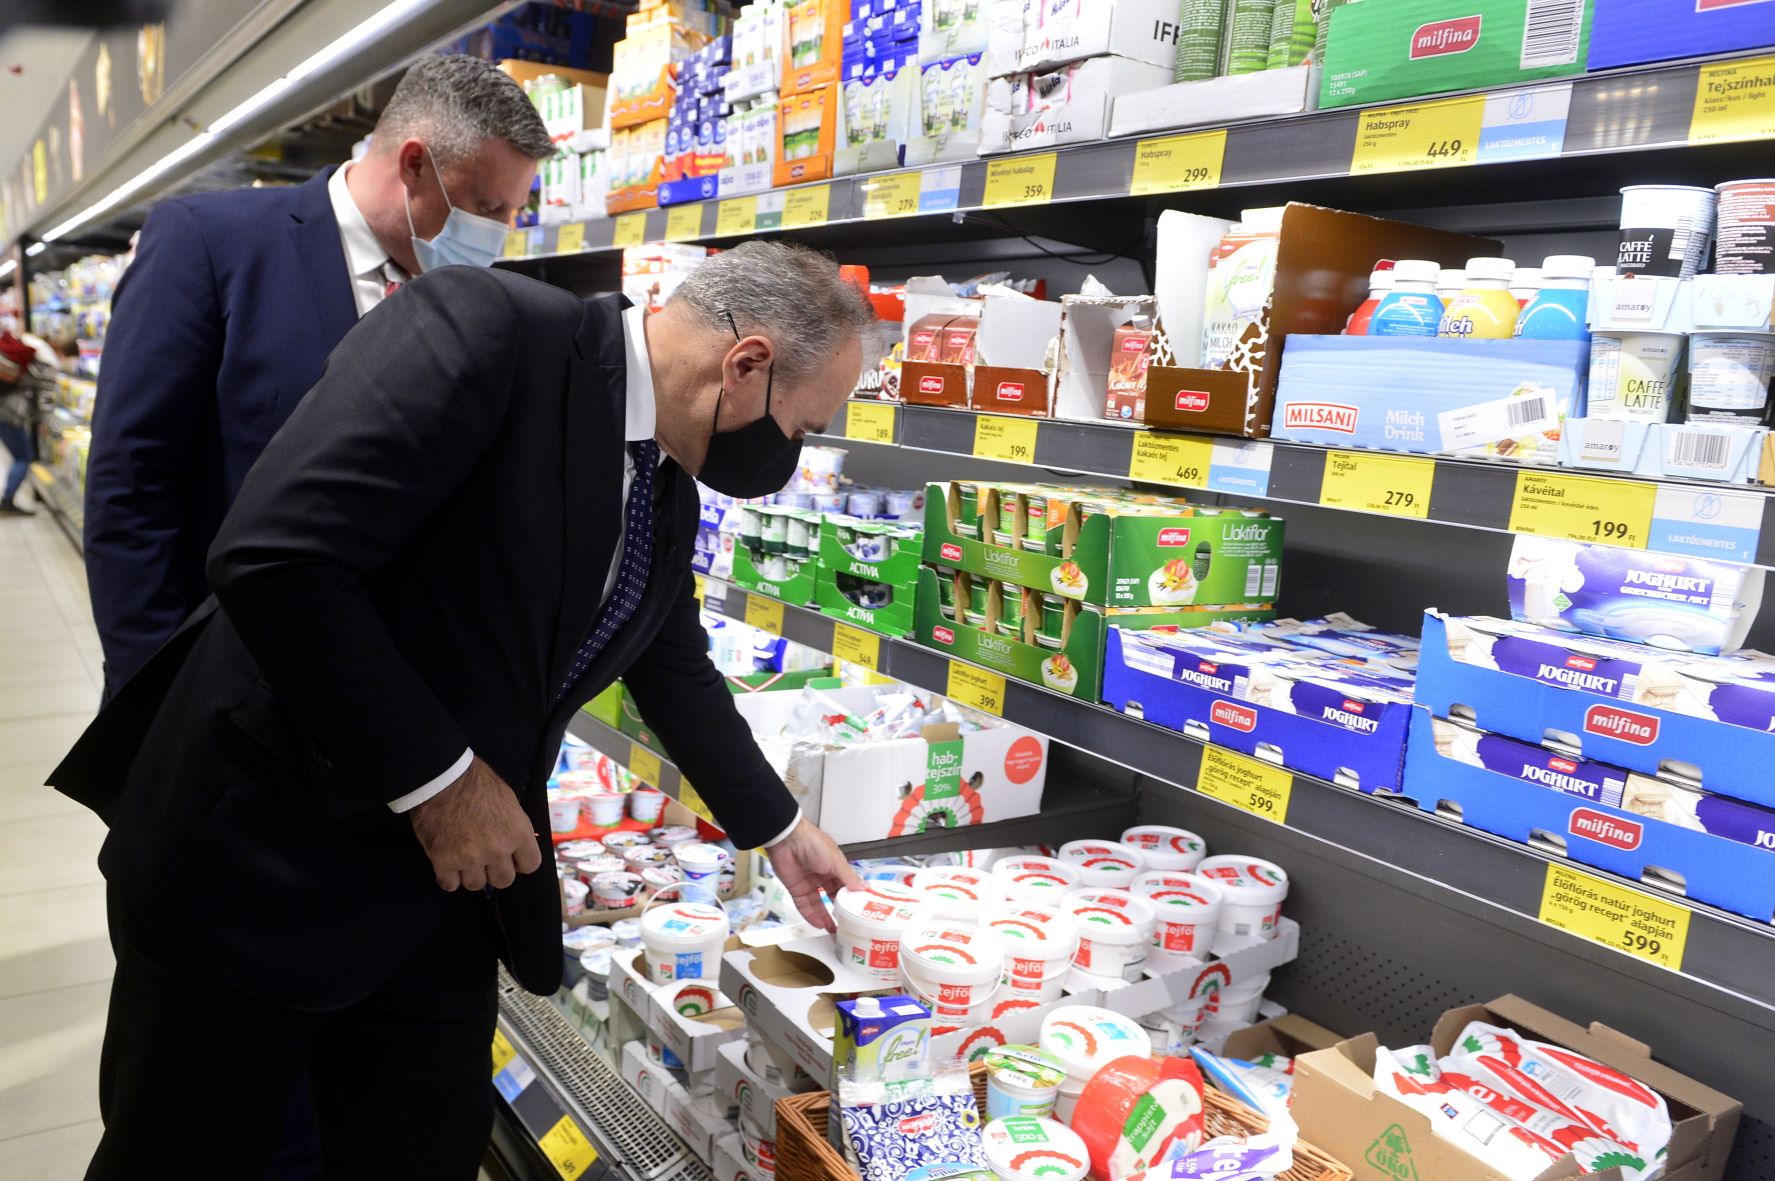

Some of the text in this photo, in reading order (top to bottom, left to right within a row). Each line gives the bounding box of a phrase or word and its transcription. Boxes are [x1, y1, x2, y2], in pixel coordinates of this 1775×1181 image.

[1051, 36, 1080, 50] ITALIA
[1416, 27, 1473, 49] milfina
[1046, 121, 1072, 135] ITLIA
[1366, 119, 1411, 131] Habspray
[1140, 150, 1172, 159] Habspray
[1427, 139, 1462, 158] 449
[1183, 167, 1208, 182] 299
[1023, 184, 1042, 198] 359
[899, 200, 913, 211] 279
[1618, 252, 1651, 263] LATTE
[1211, 322, 1238, 335] KAKAO
[1440, 315, 1474, 334] ilch
[1209, 336, 1233, 349] MILCH
[1178, 394, 1207, 408] milfina
[1624, 393, 1662, 409] LATTE
[1288, 407, 1352, 428] MILSANI
[1386, 409, 1425, 426] Milch
[1384, 425, 1425, 442] Drink
[1010, 445, 1026, 457] 199
[1138, 440, 1180, 452] Laktózmentes
[1137, 449, 1168, 461] kakaós tej
[1176, 466, 1198, 480] 469
[1332, 460, 1357, 471] Tejital
[1384, 490, 1414, 507] 279
[1523, 484, 1565, 497] Kávéital
[1592, 520, 1628, 539] 199
[1160, 532, 1187, 544] milfina
[1623, 569, 1711, 593] JOGHURT
[1568, 658, 1595, 669] milfina
[1181, 668, 1232, 691] JOGHURT
[1536, 663, 1618, 694] JOGHURT
[980, 694, 996, 708] 399
[1215, 708, 1252, 726] milfina
[1322, 706, 1379, 733] JOGHURT
[1591, 712, 1653, 739] milfina
[931, 750, 958, 766] hab-
[1236, 765, 1263, 782] joghurt
[1551, 761, 1575, 772] milfina
[1520, 764, 1599, 797] JOGHURT
[1255, 784, 1281, 800] alapján
[1249, 793, 1273, 812] 599
[1576, 816, 1635, 844] milfina
[1553, 875, 1676, 928] Élőflórás natúr joghurt
[1630, 919, 1674, 940] alapján
[1622, 930, 1661, 955] 599
